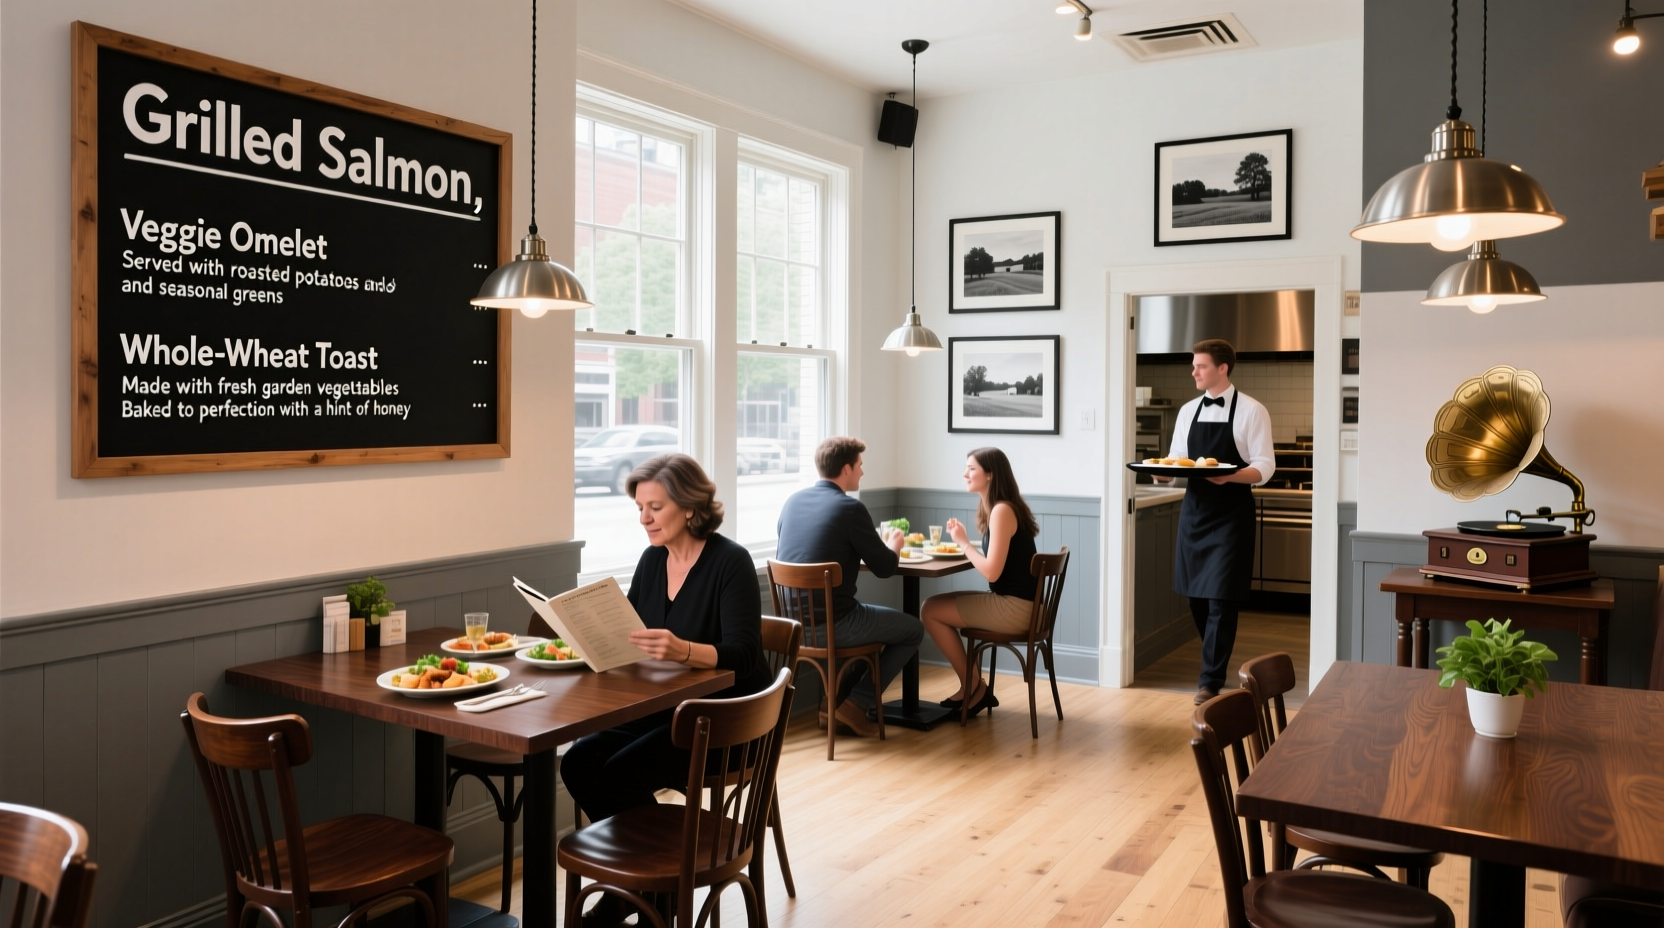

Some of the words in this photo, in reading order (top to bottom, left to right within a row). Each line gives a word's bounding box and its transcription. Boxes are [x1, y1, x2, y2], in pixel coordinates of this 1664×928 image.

[122, 83, 302, 172] Grilled
[318, 125, 483, 215] Salmon,
[120, 208, 222, 255] Veggie
[230, 221, 328, 260] Omelet
[122, 249, 183, 273] Served
[189, 258, 224, 277] with
[231, 264, 290, 283] roasted
[121, 276, 153, 295] and
[159, 282, 228, 300] seasonal
[232, 288, 284, 306] greens
[120, 333, 309, 369] Whole-Wheat
[316, 341, 379, 370] Toast
[122, 375, 171, 394] Made
[176, 377, 213, 394] with
[218, 377, 257, 395] fresh
[262, 378, 312, 400] garden
[122, 399, 172, 418] Baked
[177, 401, 194, 418] to
[199, 399, 275, 424] perfection
[280, 400, 309, 417] with
[314, 404, 322, 417] a
[326, 399, 352, 417] hint
[356, 399, 371, 416] of
[373, 399, 412, 421] honey
